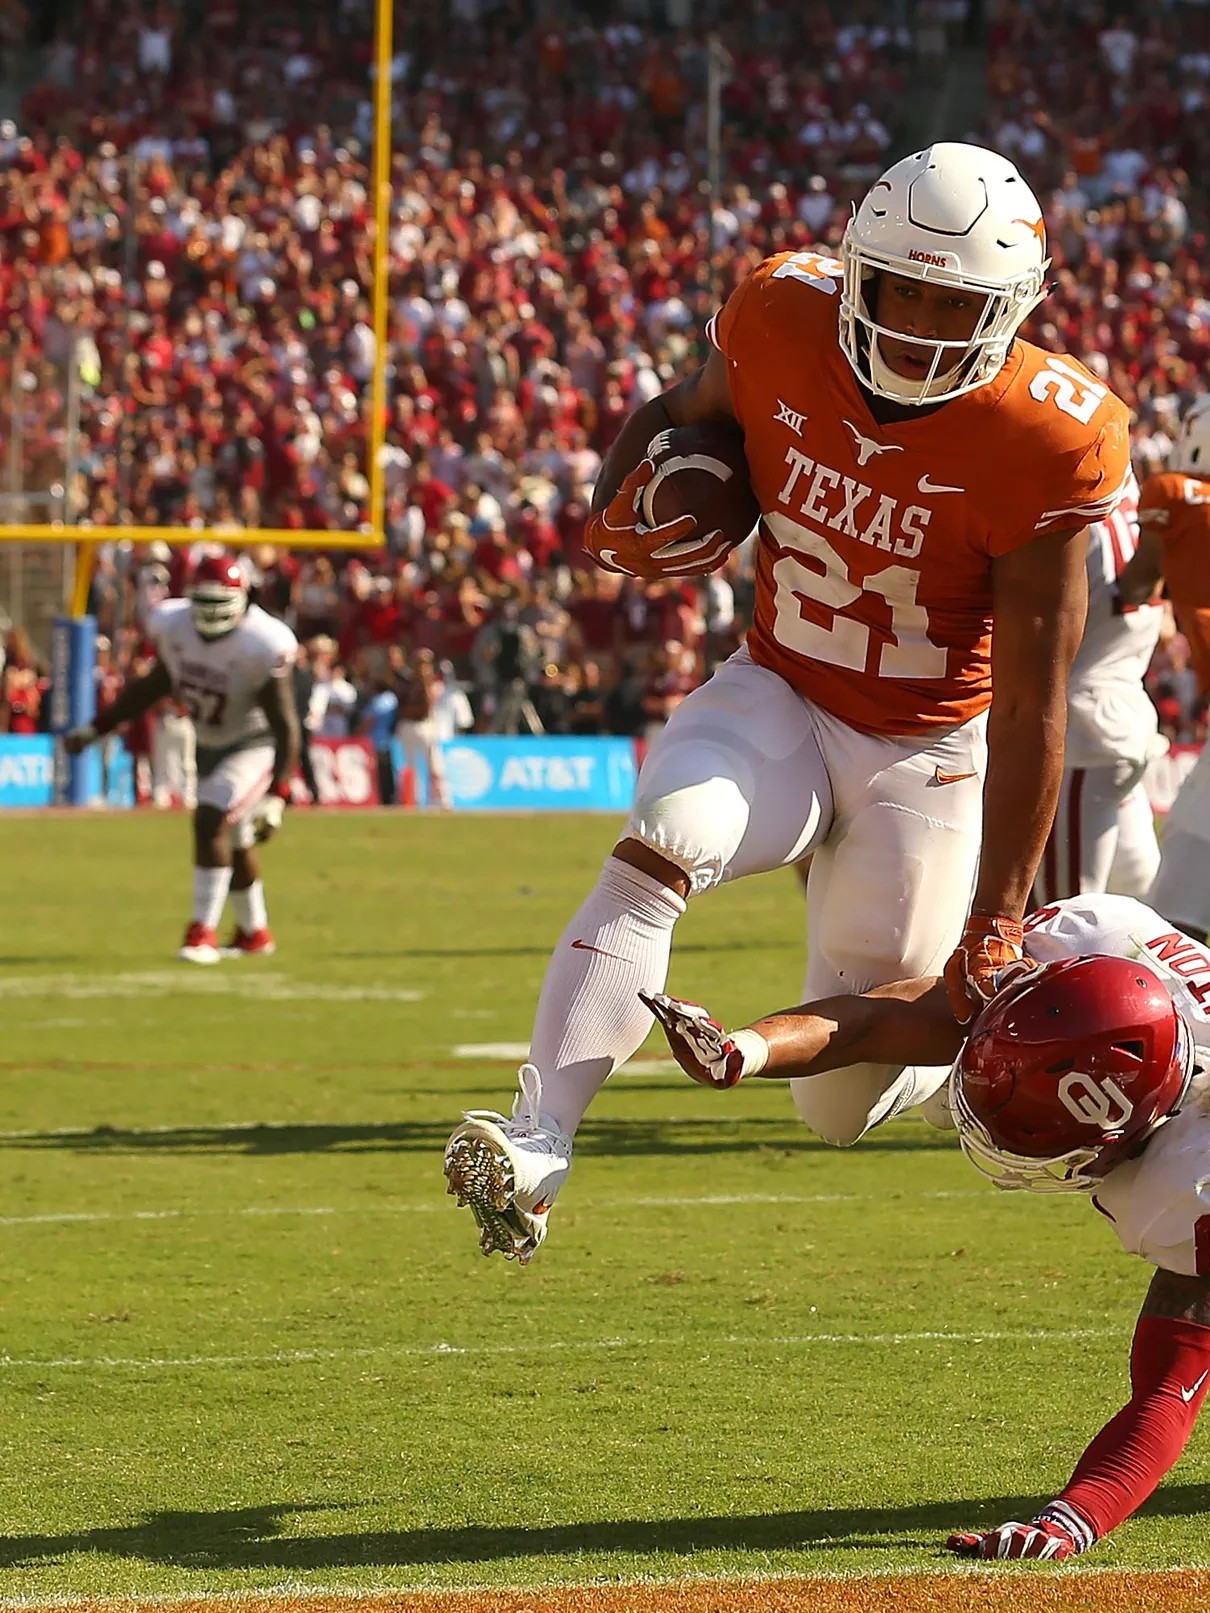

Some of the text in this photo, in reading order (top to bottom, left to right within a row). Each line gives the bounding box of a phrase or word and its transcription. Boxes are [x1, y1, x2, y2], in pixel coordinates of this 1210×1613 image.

[908, 249, 947, 268] HORNS
[1028, 357, 1108, 426] 21
[777, 446, 932, 559] TEXAS
[763, 511, 948, 679] 21
[501, 756, 596, 790] AT&T
[1057, 1071, 1134, 1130] OU
